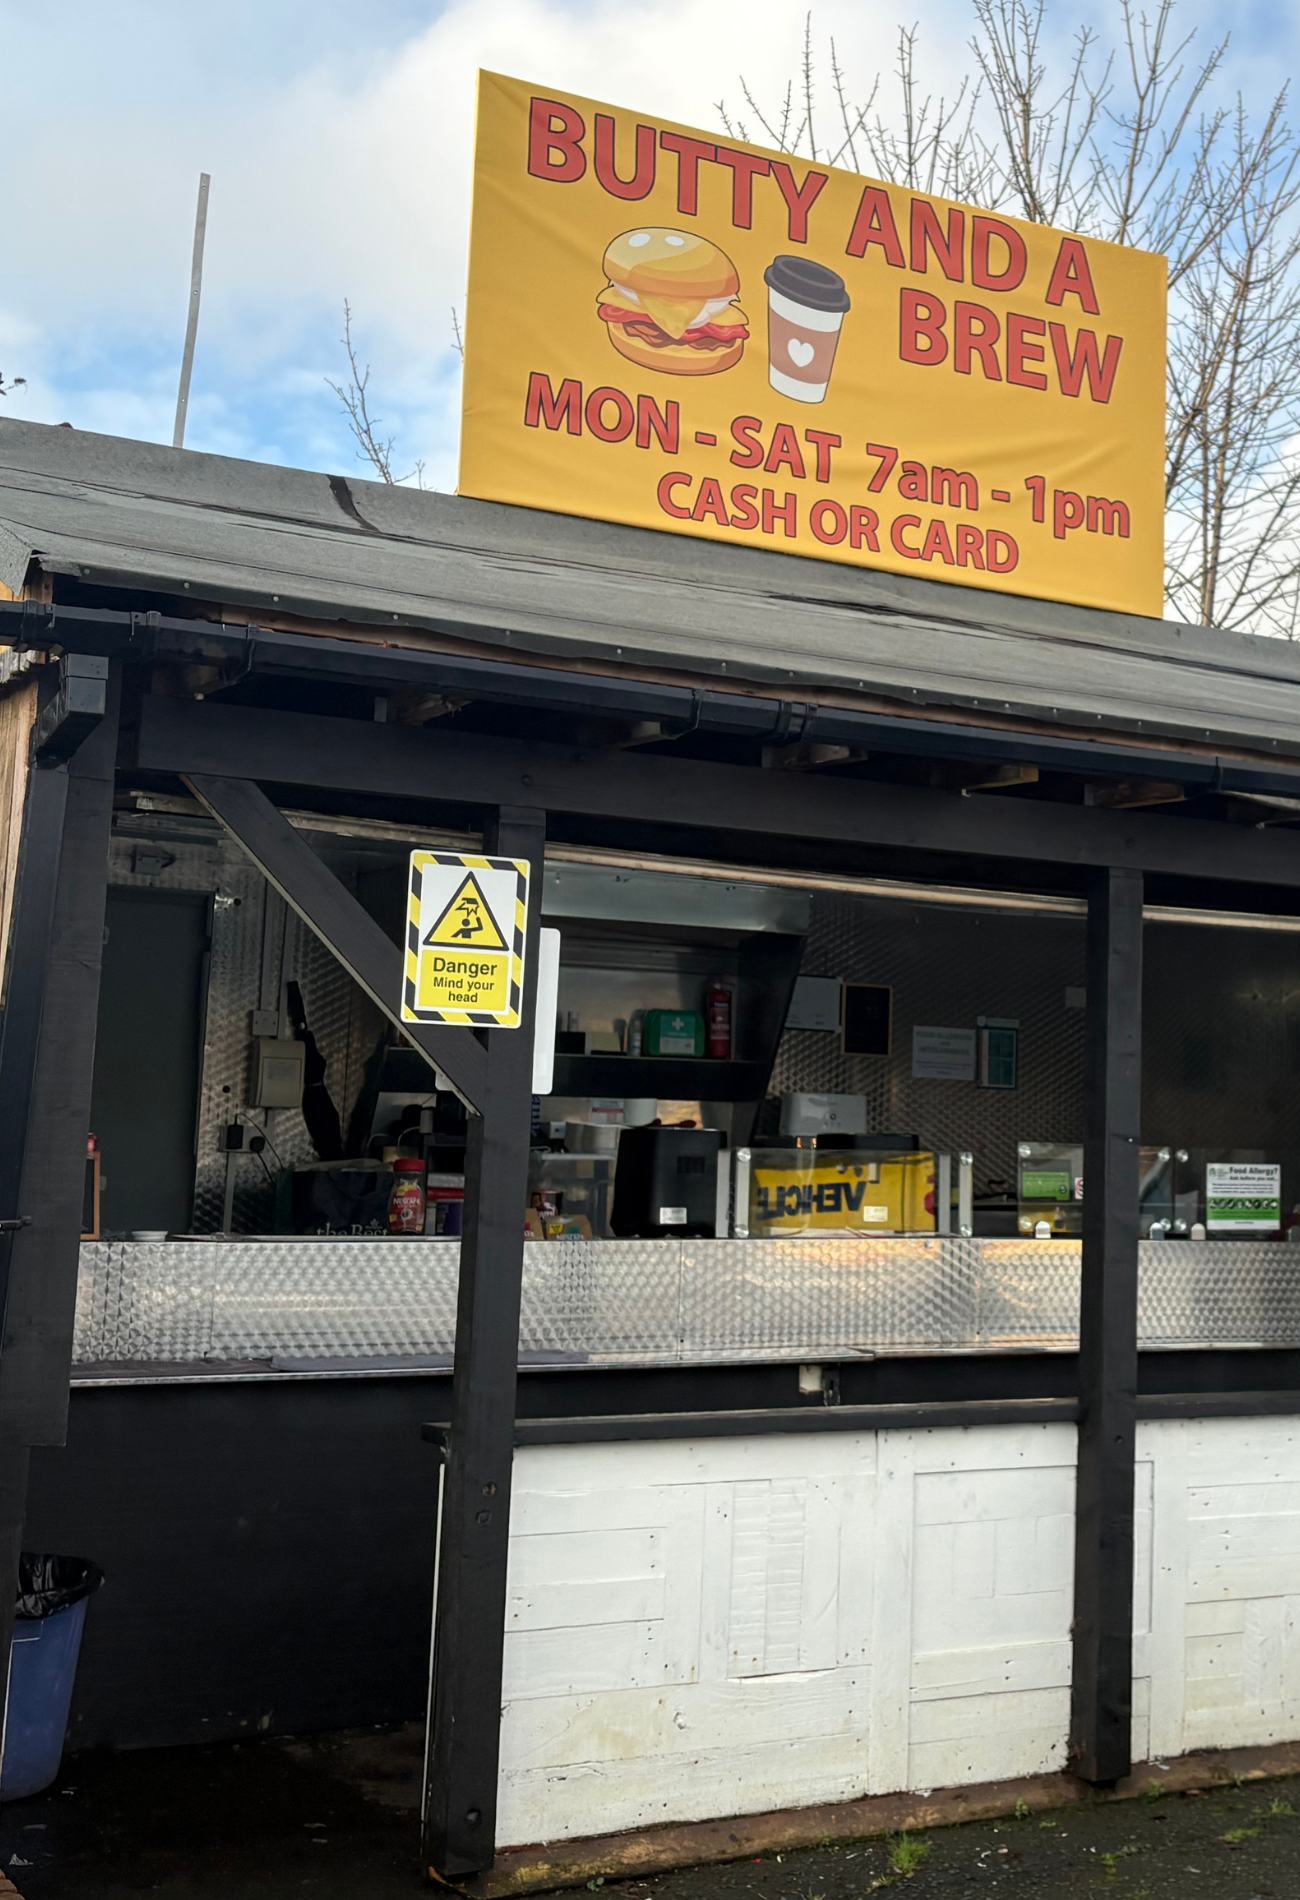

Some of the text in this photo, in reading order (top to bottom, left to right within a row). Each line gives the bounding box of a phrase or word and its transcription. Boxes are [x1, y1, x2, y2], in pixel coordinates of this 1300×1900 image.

[528, 97, 1100, 316] BUTTY AND A
[899, 287, 1124, 404] BREW
[524, 372, 1131, 540] MON - SAT 7am - 1pm
[656, 471, 1020, 574] CASH OR CARD
[433, 957, 497, 977] Danger
[433, 977, 495, 992] Mind your
[448, 991, 478, 1003] head
[1229, 1166, 1247, 1174] Food
